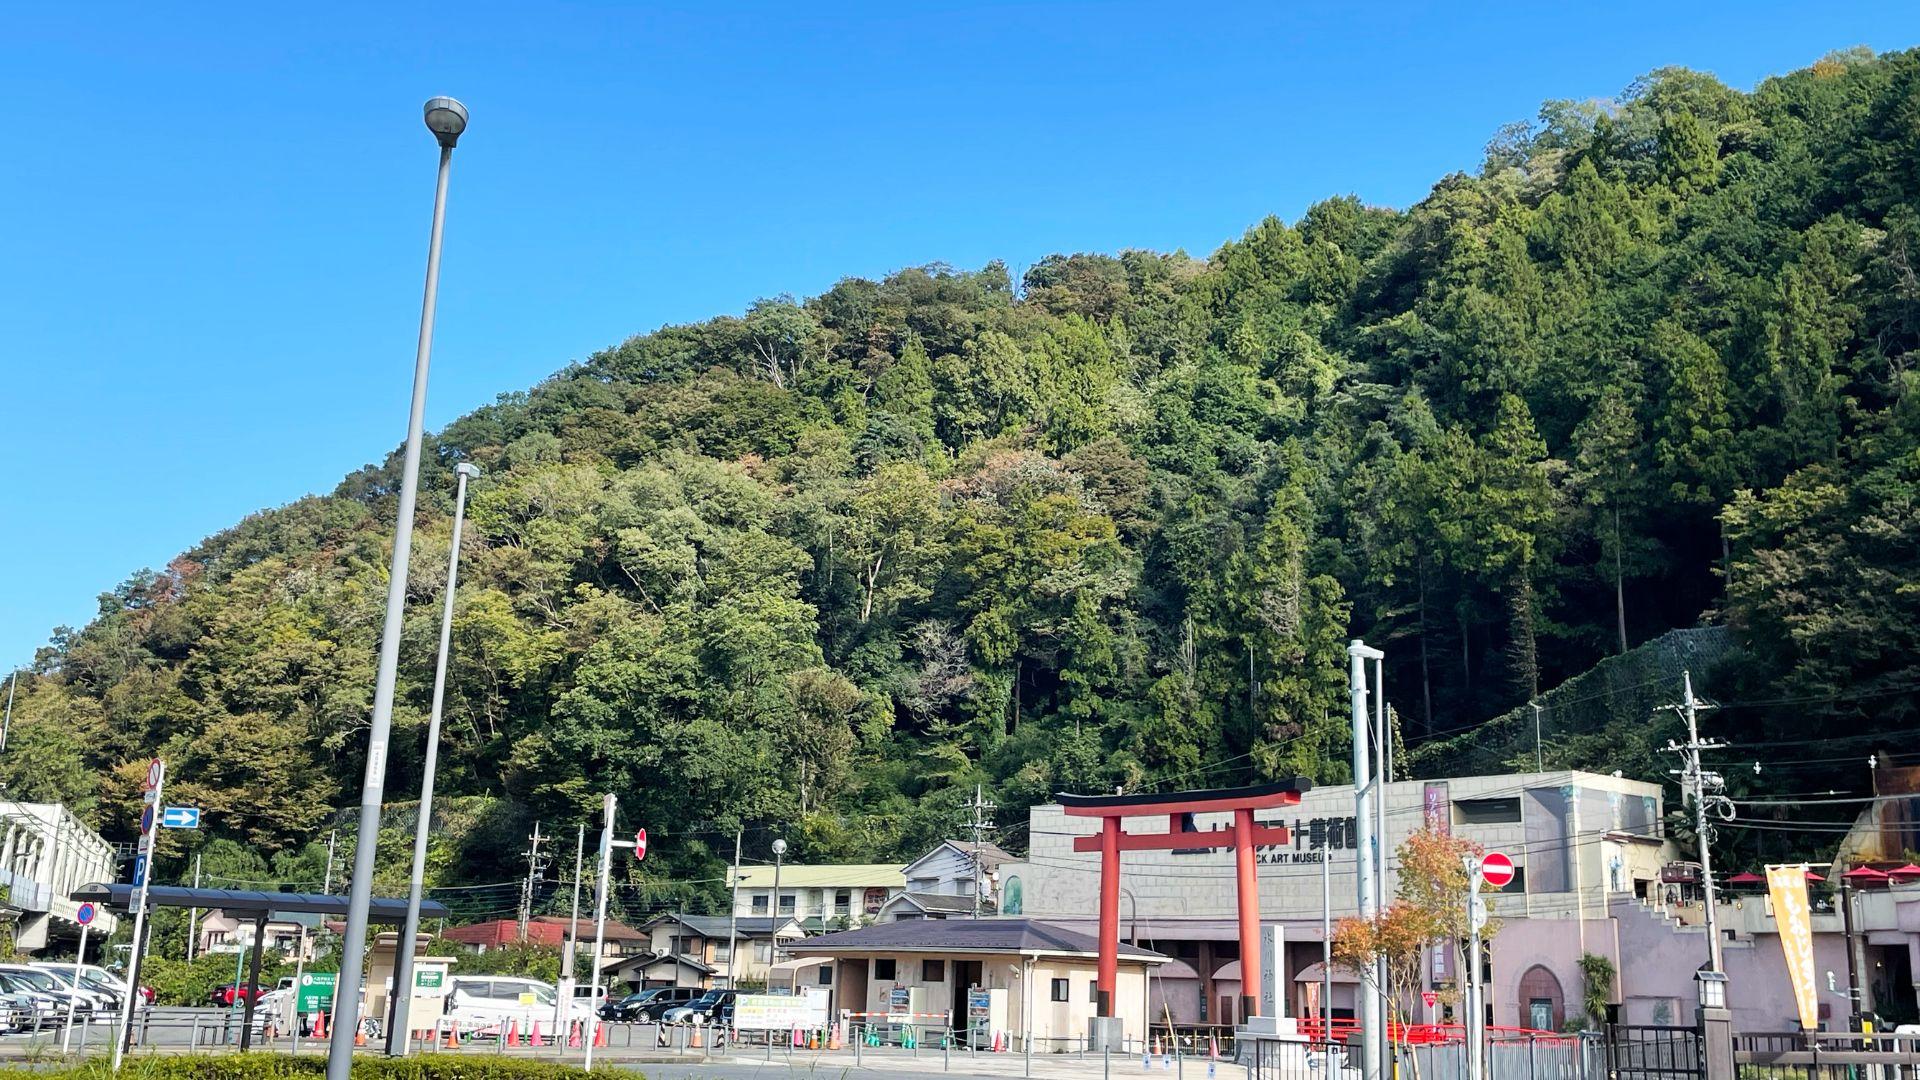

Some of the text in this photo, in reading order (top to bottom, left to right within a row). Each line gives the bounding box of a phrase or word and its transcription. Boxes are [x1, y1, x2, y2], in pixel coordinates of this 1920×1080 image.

[1271, 853, 1289, 863] ART
[1292, 852, 1332, 863] MUSEU
[135, 857, 145, 886] P
